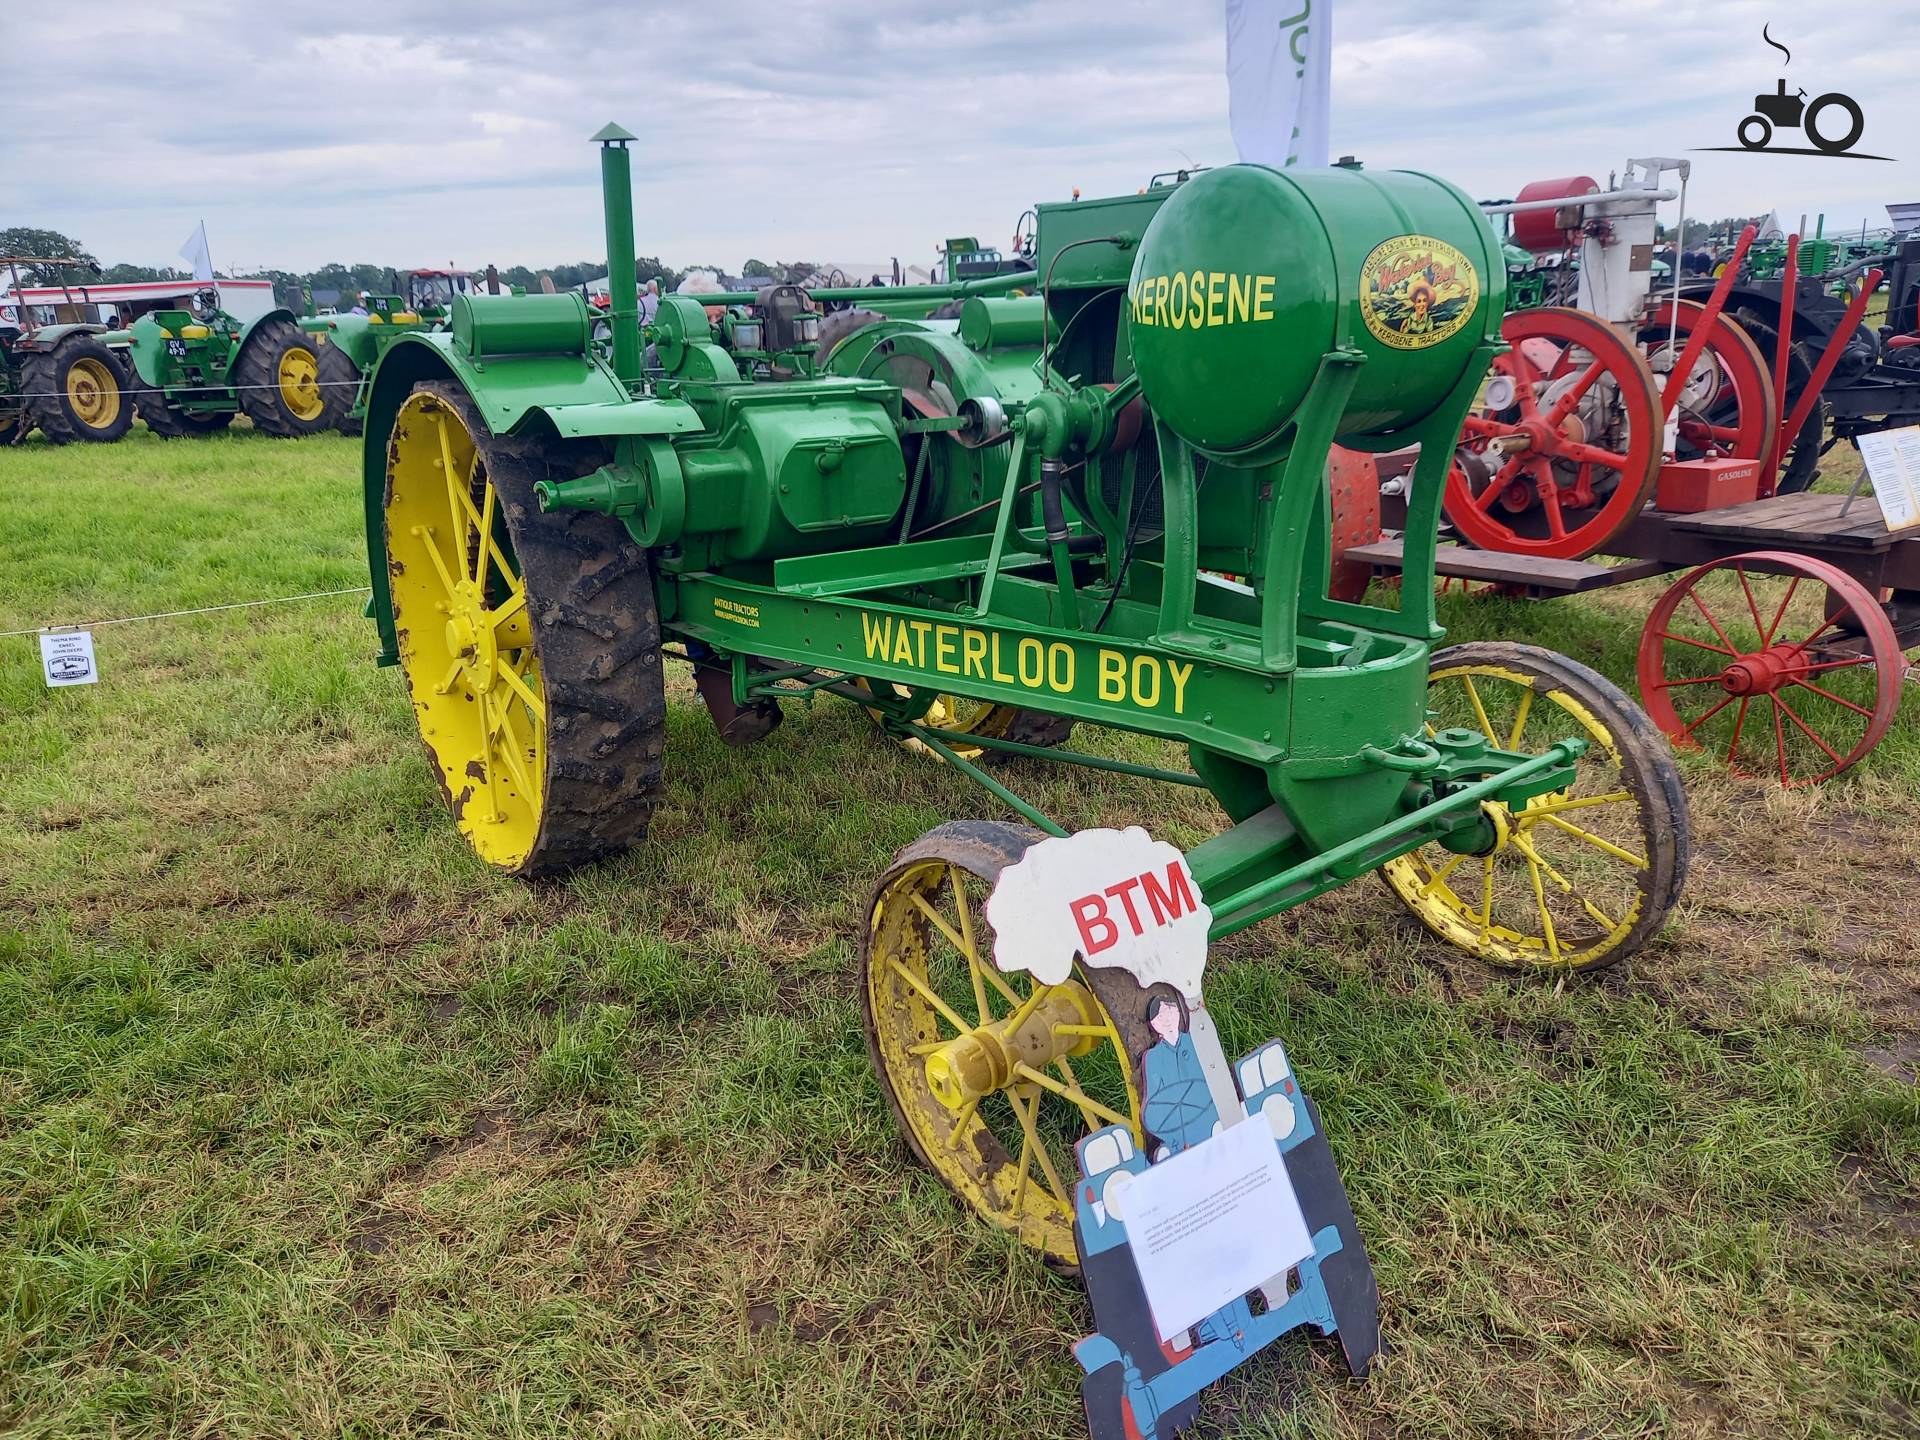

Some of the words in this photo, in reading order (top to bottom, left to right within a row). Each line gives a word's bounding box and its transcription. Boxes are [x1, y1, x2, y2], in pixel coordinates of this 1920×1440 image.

[1132, 270, 1276, 330] KEROSENE
[1376, 326, 1414, 347] KEROSENE
[1417, 322, 1457, 347] TRACTORS
[1717, 468, 1753, 481] GASOLINE
[714, 597, 734, 611] ANTIQUE
[733, 602, 759, 618] TRACTORS
[860, 610, 1076, 694] WATERLOO
[1097, 647, 1195, 715] BOY
[1068, 860, 1198, 956] BTM
